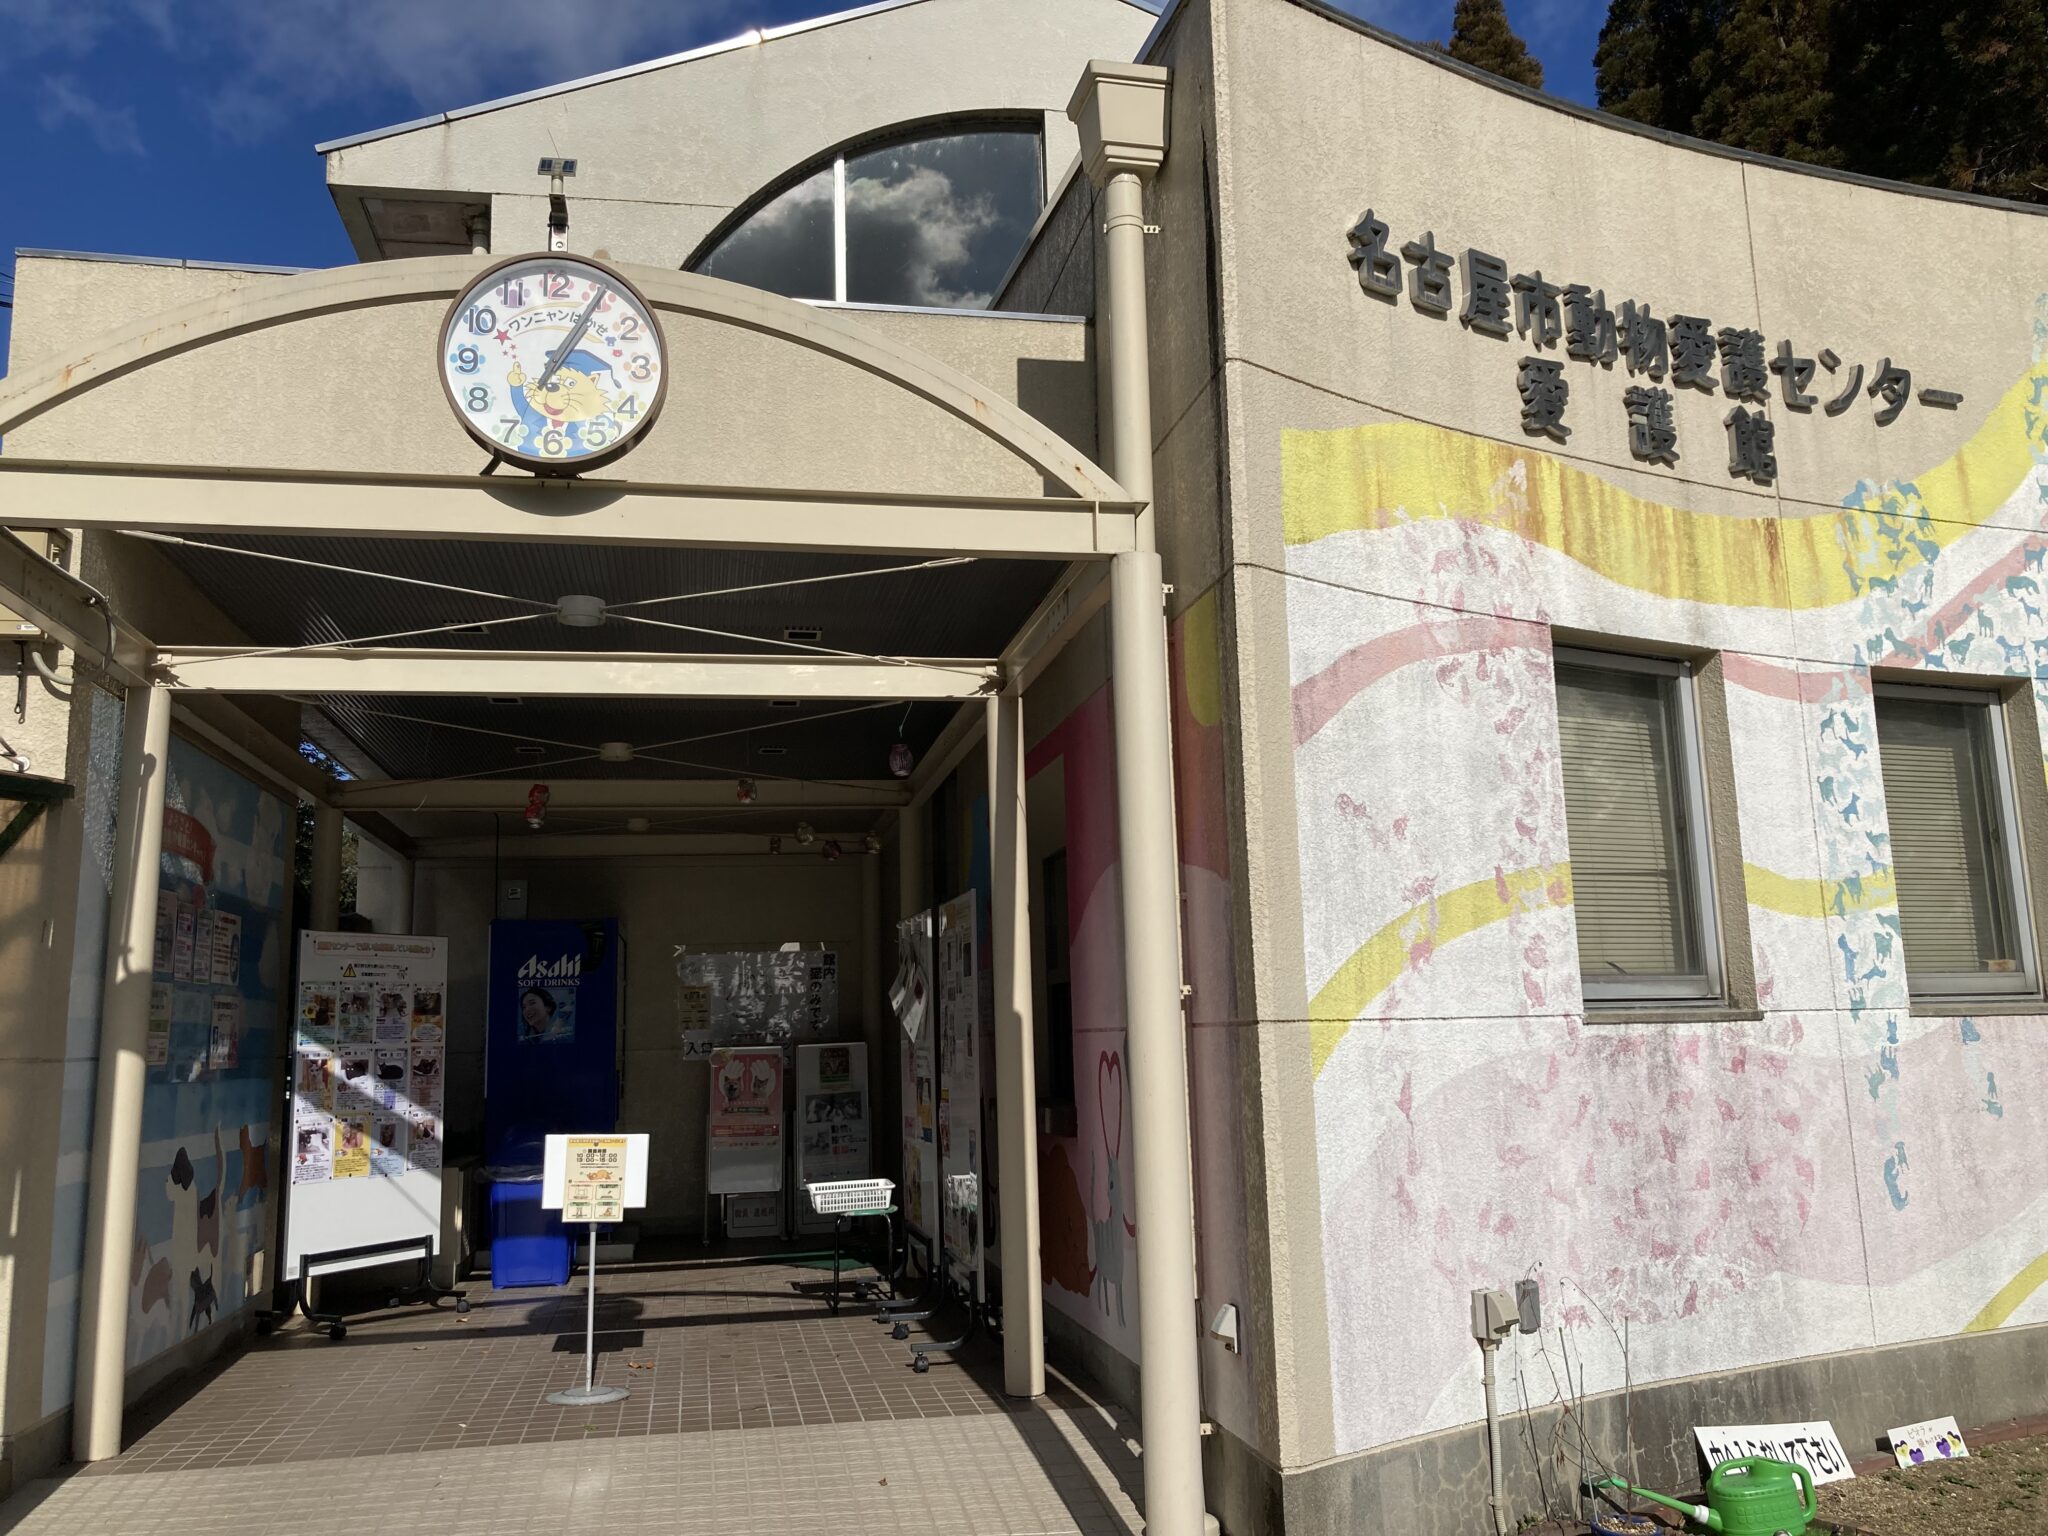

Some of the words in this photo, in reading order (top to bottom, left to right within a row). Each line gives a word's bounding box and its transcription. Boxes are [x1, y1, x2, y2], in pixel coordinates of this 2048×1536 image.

[503, 279, 523, 306] 11
[543, 271, 571, 298] 12
[468, 308, 497, 334] 10
[620, 317, 639, 341] 2
[1347, 208, 1964, 427] 名古屋市動物愛護センター
[458, 347, 479, 373] 9
[631, 355, 650, 380] 3
[467, 387, 489, 412] 8
[617, 395, 638, 419] 4
[500, 419, 520, 443] 7
[1517, 356, 1778, 486] 愛護館
[543, 430, 563, 455] 6
[586, 422, 607, 447] 5
[517, 953, 581, 979] Asahi
[517, 979, 542, 987] SOFT
[544, 978, 581, 986] DRINKS
[686, 1042, 713, 1055] 入口
